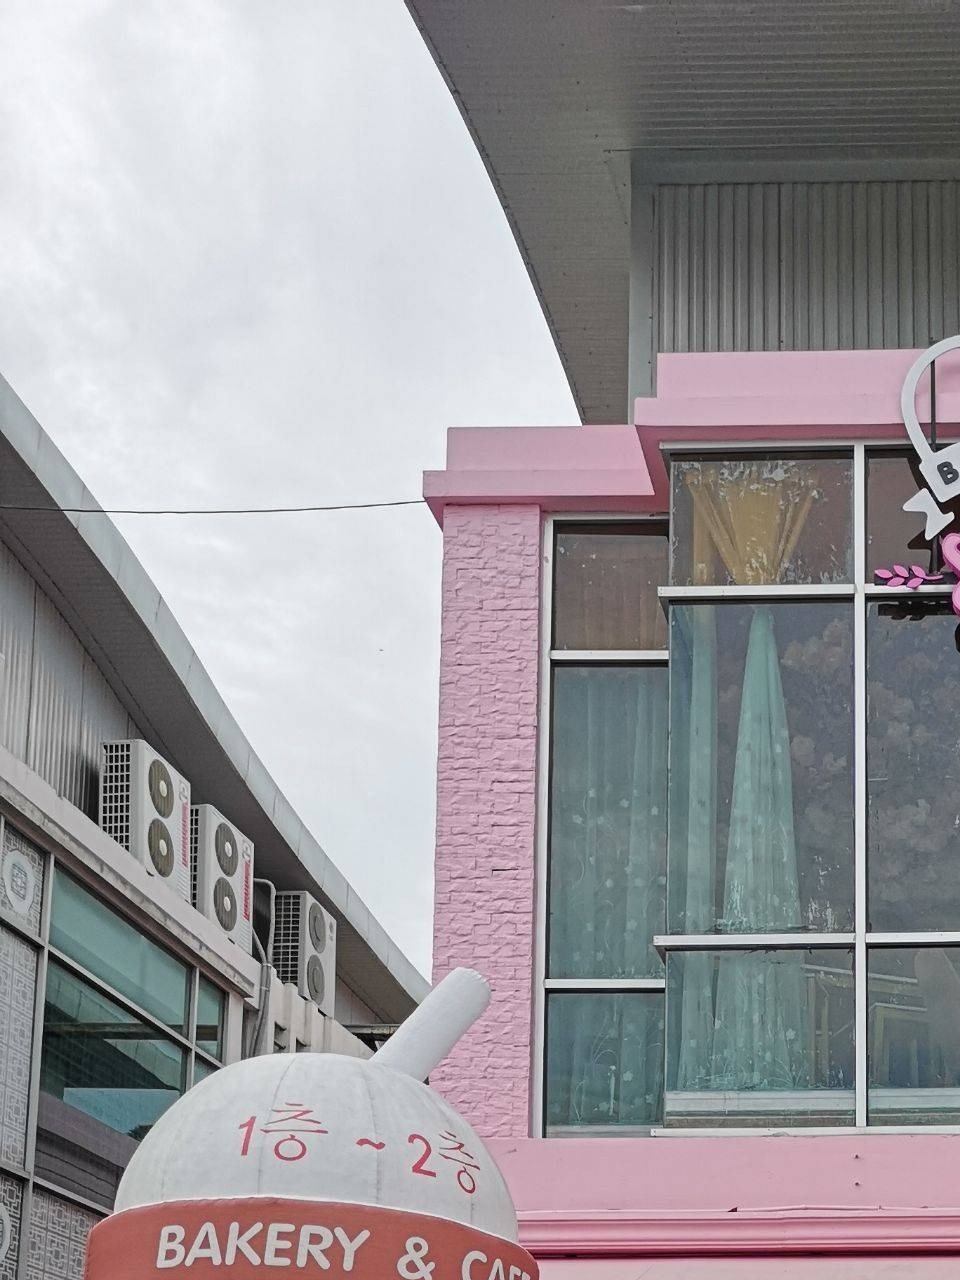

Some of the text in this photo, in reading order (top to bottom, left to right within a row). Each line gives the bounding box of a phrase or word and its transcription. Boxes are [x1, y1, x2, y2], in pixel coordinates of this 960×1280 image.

[239, 1102, 328, 1161] 1층
[408, 1131, 481, 1194] 2층
[156, 1221, 371, 1272] BAKERY
